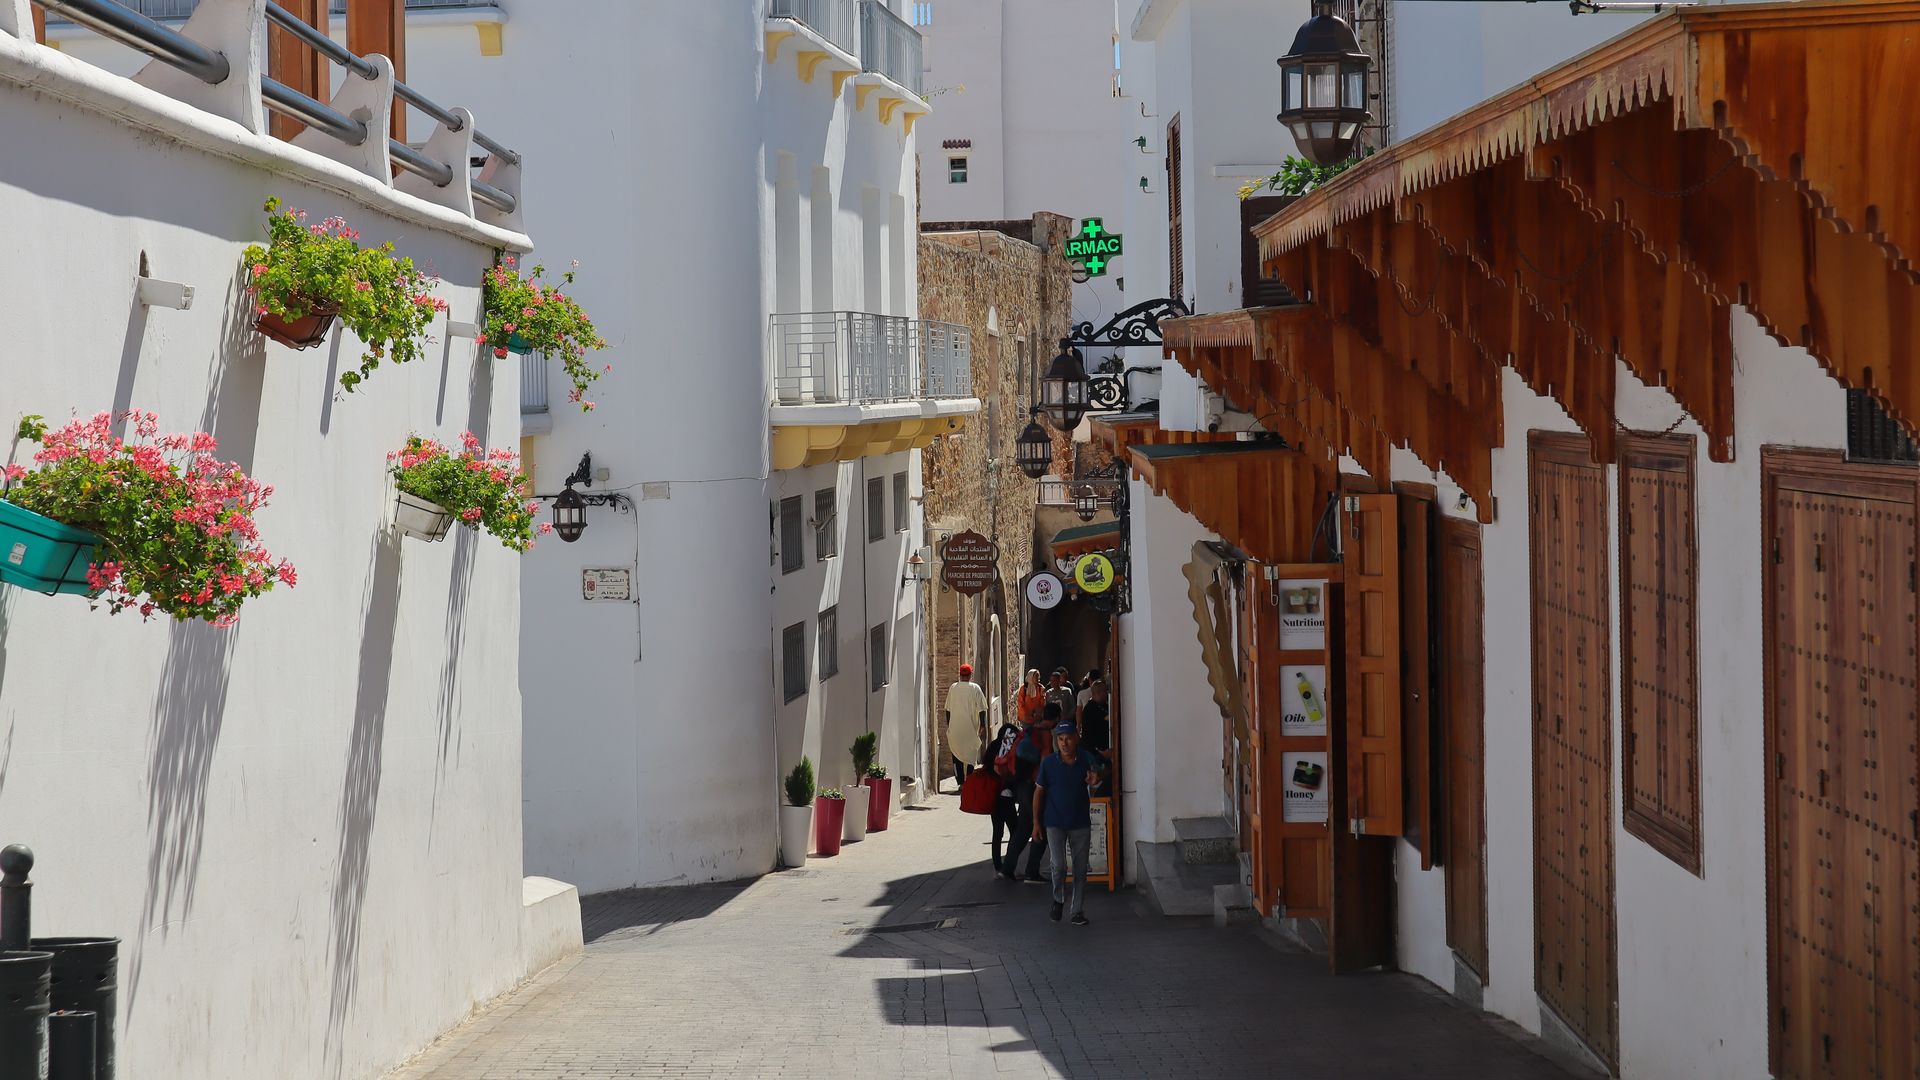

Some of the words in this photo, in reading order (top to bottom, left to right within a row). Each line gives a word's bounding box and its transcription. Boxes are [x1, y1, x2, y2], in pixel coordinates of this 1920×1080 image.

[1283, 618, 1325, 627] Nutrition
[1284, 713, 1306, 723] Oils
[1285, 790, 1315, 800] Honey
